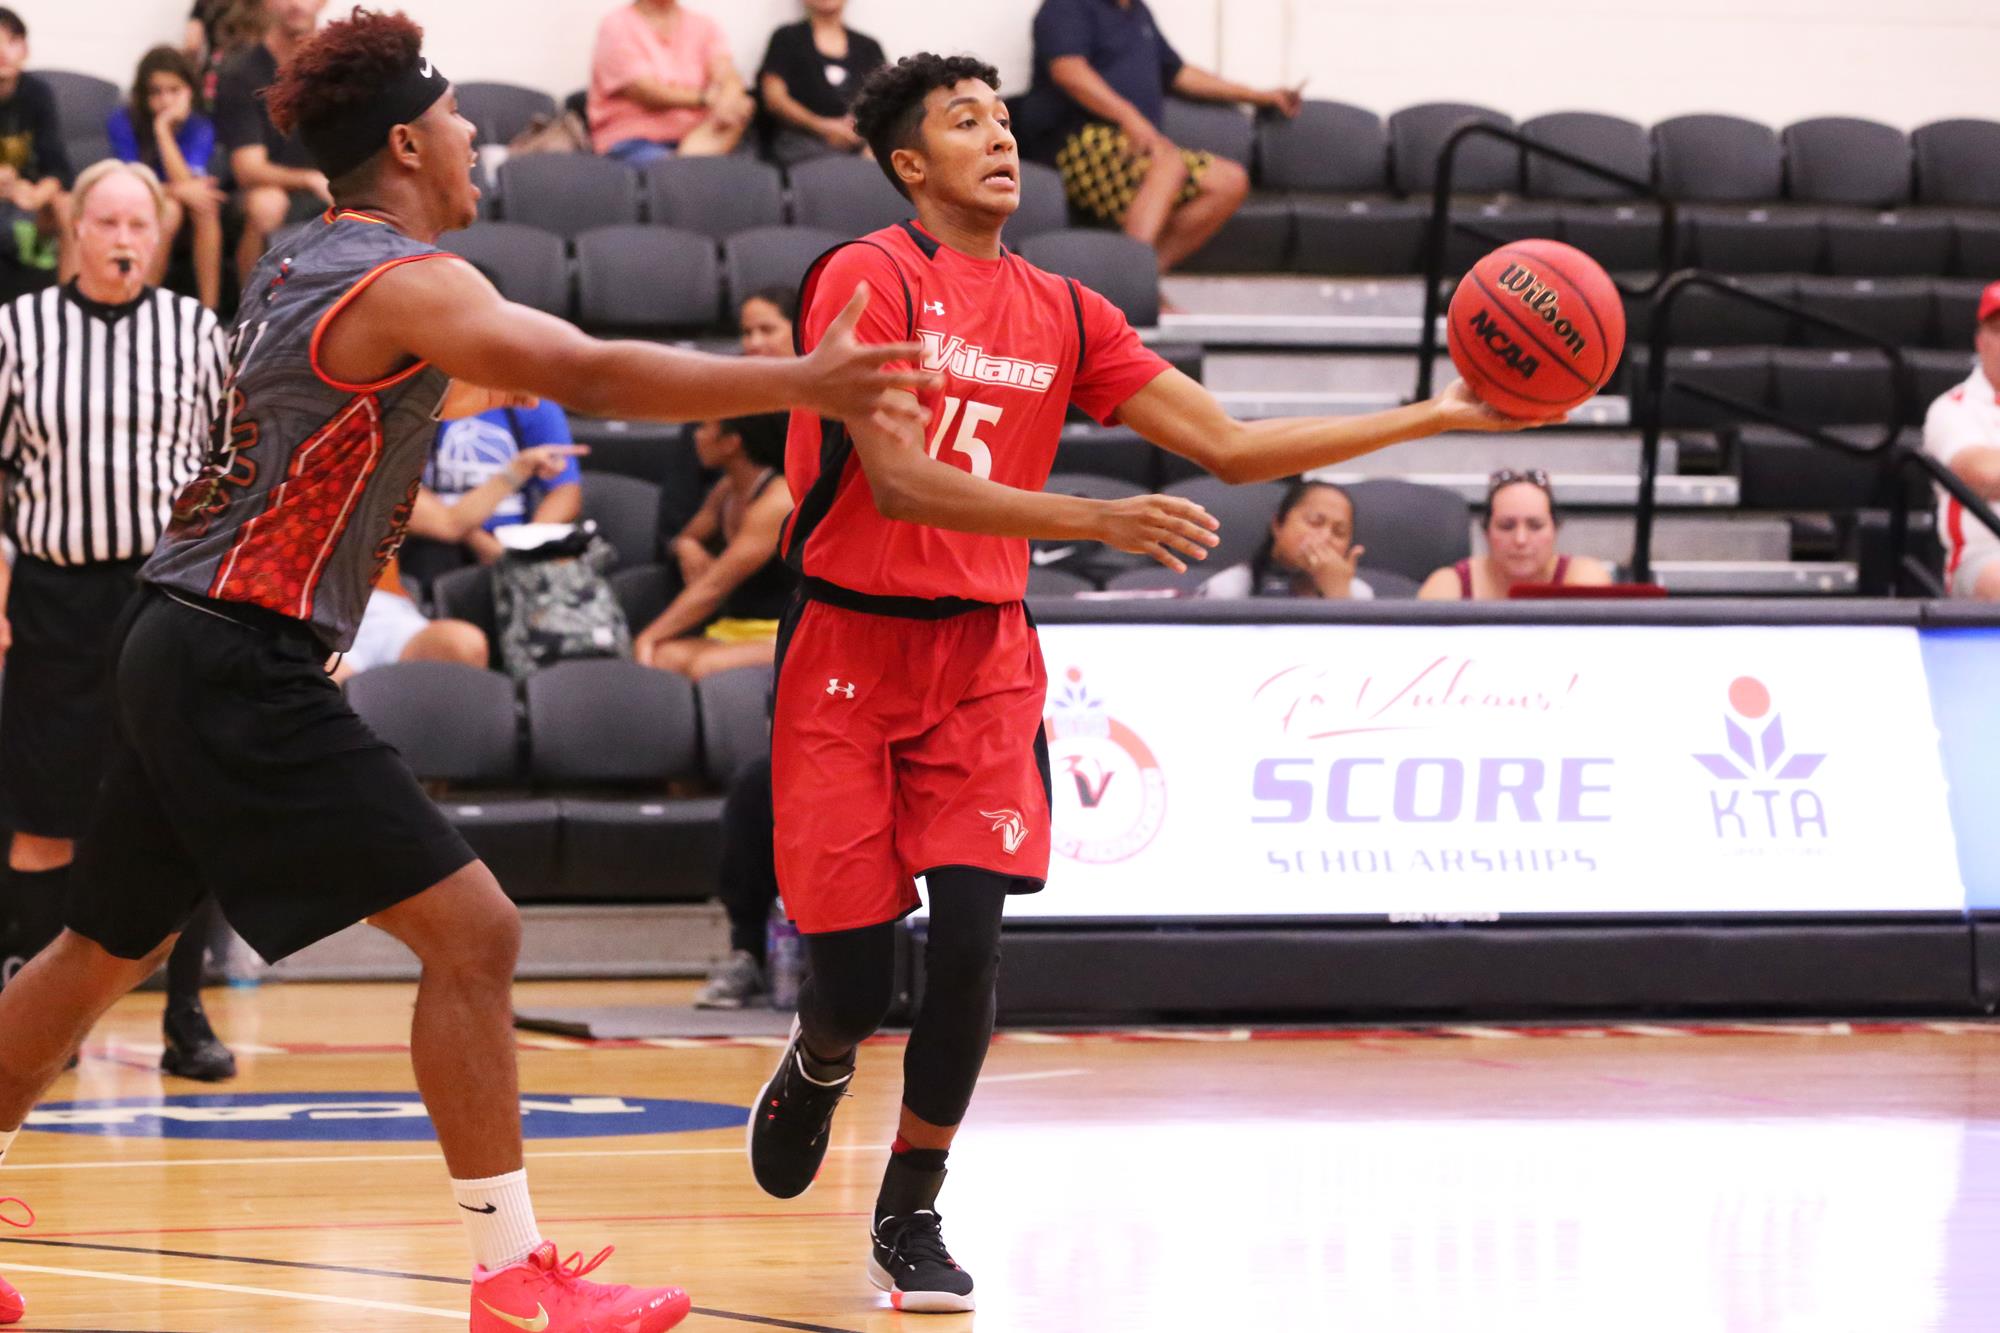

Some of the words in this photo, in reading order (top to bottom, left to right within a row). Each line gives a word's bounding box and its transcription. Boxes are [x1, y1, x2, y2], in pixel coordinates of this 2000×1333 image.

[1470, 308, 1540, 380] NCAA
[1497, 261, 1586, 360] Wilson
[915, 329, 1057, 392] Vulcans
[929, 396, 1003, 480] 15
[1251, 757, 1615, 824] SCORE
[1709, 788, 1829, 838] KTA
[1266, 847, 1599, 873] SCHOLARSHIPS
